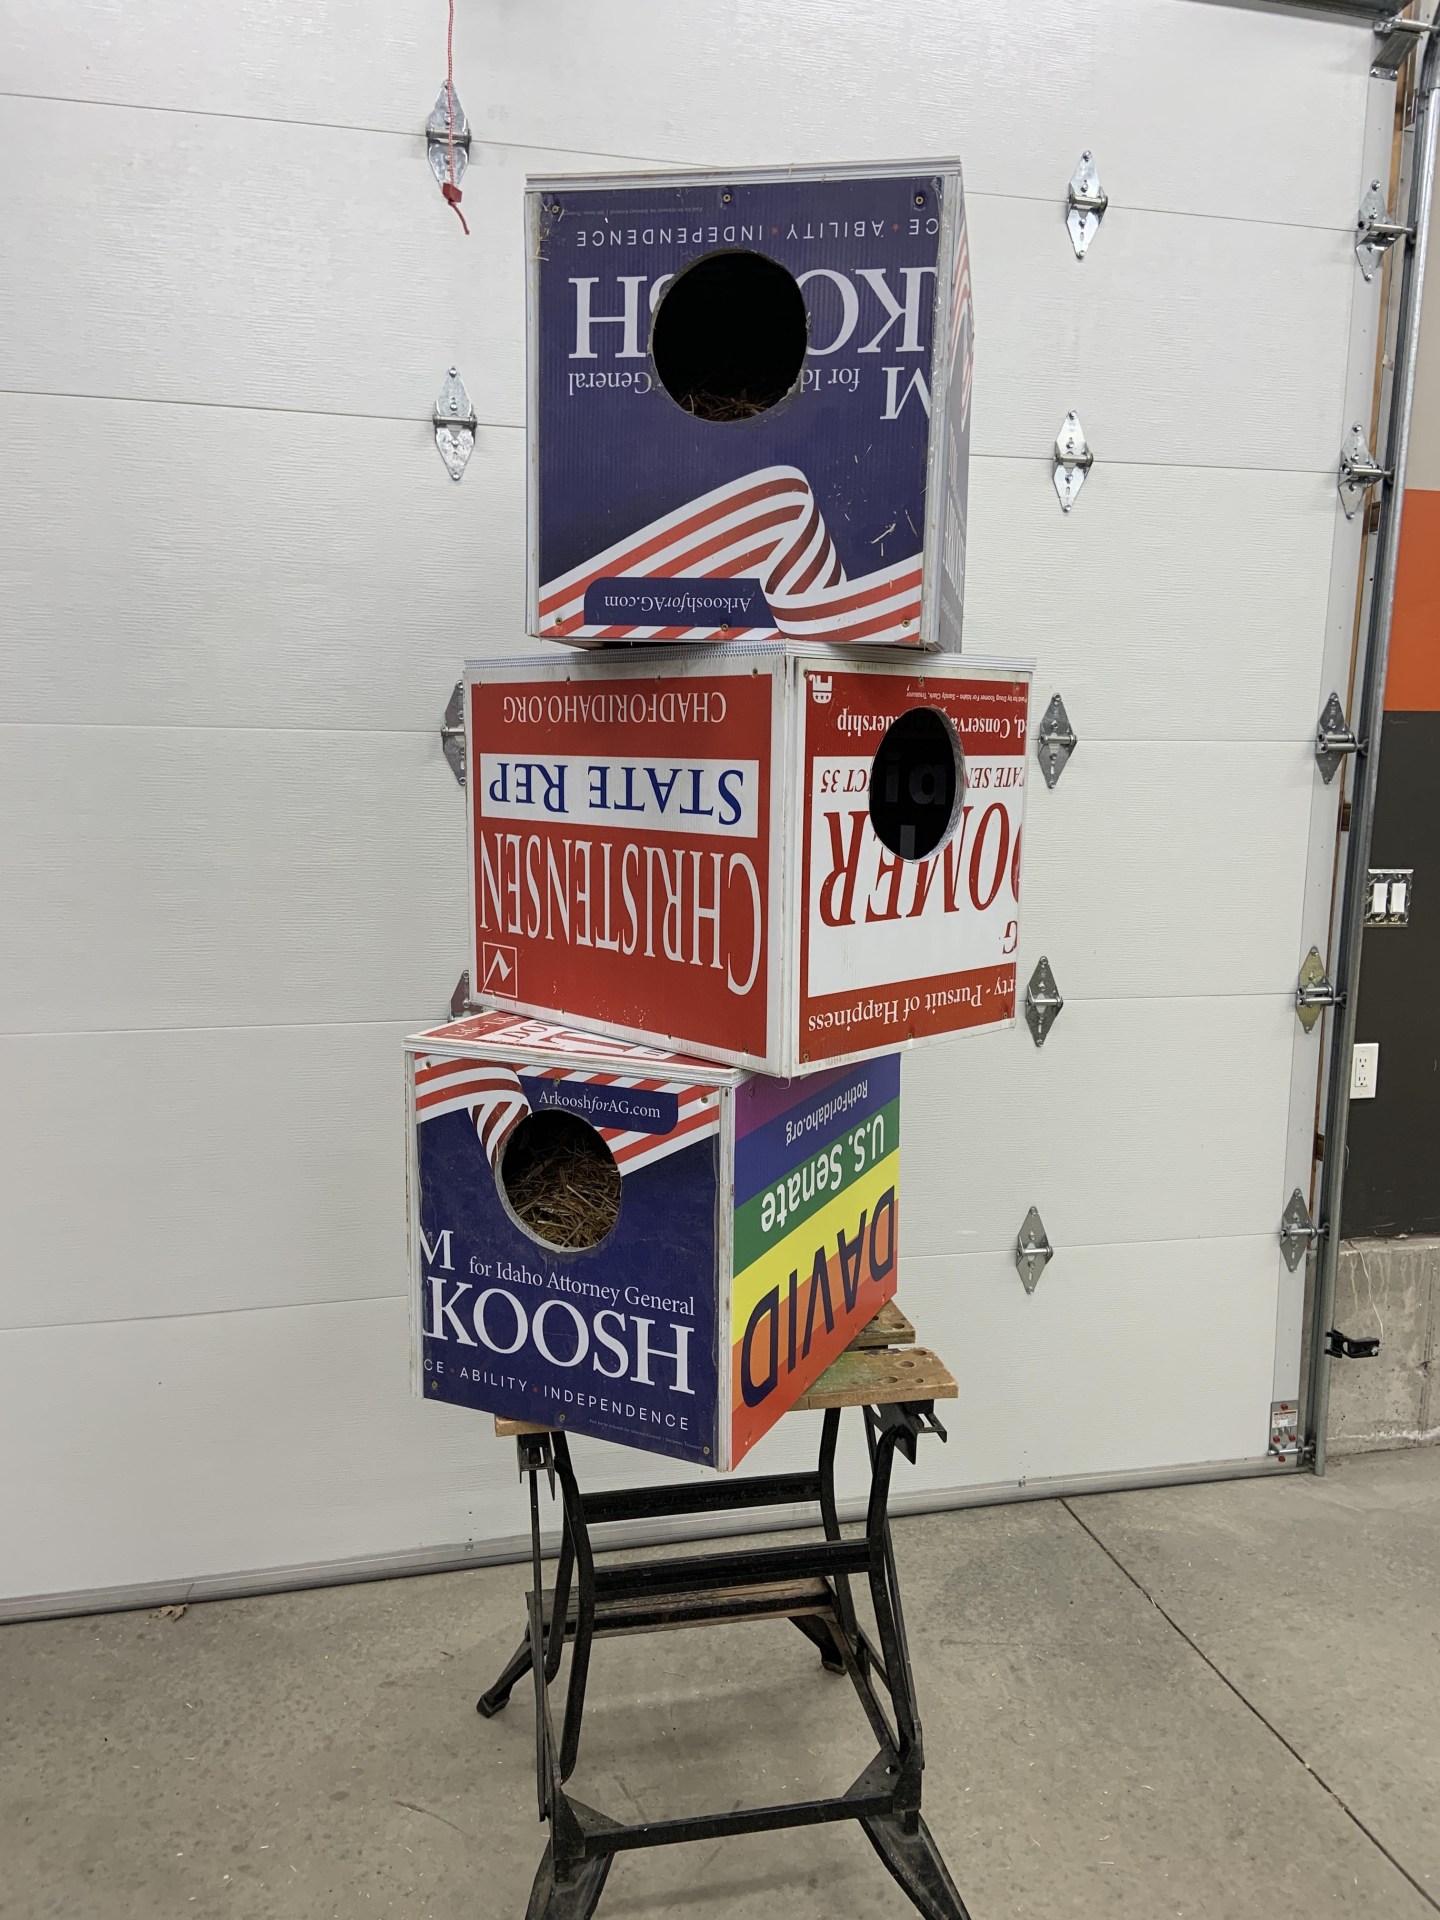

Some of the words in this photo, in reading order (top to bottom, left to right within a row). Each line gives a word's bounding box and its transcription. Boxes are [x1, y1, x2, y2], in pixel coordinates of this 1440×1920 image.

[576, 224, 763, 247] INDEPENDENCE
[786, 220, 885, 240] ABILITY
[568, 371, 652, 396] General
[827, 368, 861, 393] for
[604, 592, 752, 613] ArkooshforAG.com
[502, 691, 727, 724] CHADFORIDAHO.ORG
[905, 691, 927, 700] Treasurer
[927, 691, 941, 699] Clark,
[941, 691, 956, 700] Sandy
[959, 693, 971, 701] Idaho
[971, 693, 979, 702] For
[979, 694, 995, 702] Toomer
[995, 693, 1007, 703] Doug
[488, 762, 569, 814] REP
[820, 769, 841, 794] 35
[994, 766, 1025, 788] ATE
[587, 765, 744, 825] STATE
[819, 802, 1023, 927] OMER
[480, 830, 762, 996] CHRISTENSEN
[902, 997, 921, 1022] of
[924, 985, 983, 1014] Pursuit
[808, 1000, 899, 1032] Happiness
[538, 1090, 661, 1119] ArkooshforAG.com
[785, 1079, 869, 1147] RothForIdaho.org
[848, 1114, 885, 1174] U.S.
[761, 1143, 843, 1233] Senate
[469, 1255, 492, 1277] for
[495, 1261, 544, 1288] Idaho
[546, 1271, 621, 1307] Attorney
[624, 1285, 696, 1317] General
[740, 1185, 896, 1409] DAVID
[423, 1276, 696, 1396] KOOSH
[423, 1358, 444, 1374] CE
[459, 1366, 529, 1393] ABILITY
[543, 1385, 690, 1431] INDEPENDENCE
